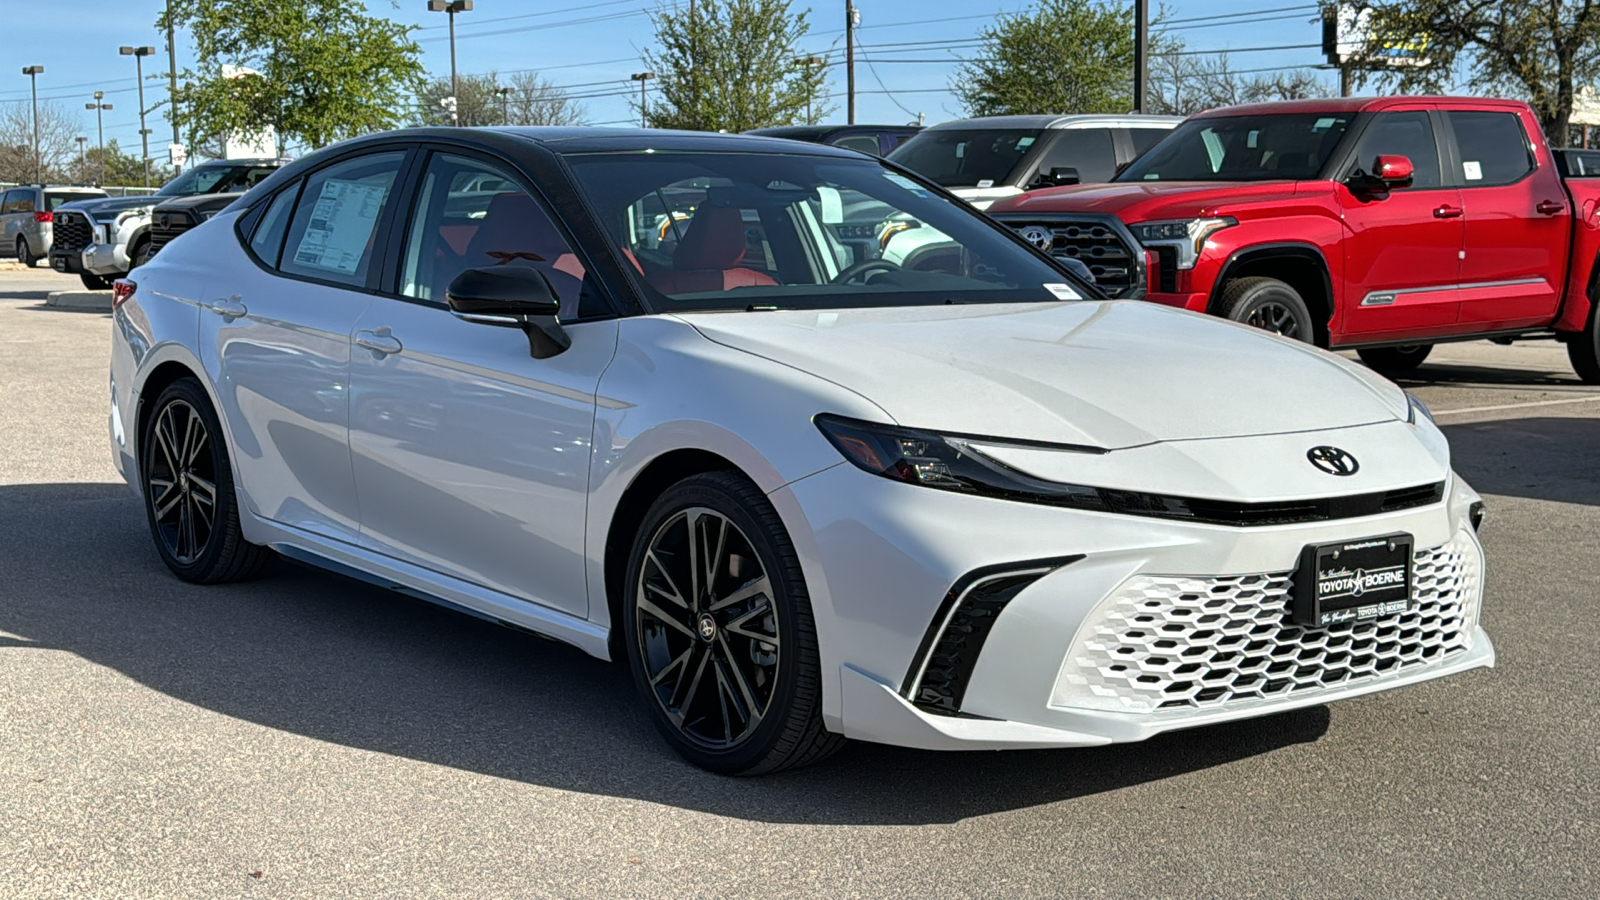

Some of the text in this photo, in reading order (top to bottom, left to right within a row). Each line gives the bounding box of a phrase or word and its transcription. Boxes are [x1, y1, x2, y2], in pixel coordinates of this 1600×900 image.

[1319, 570, 1405, 594] TOYOTA BOERNE
[1358, 607, 1378, 617] TOYOTA
[1387, 602, 1408, 612] BOERNE
